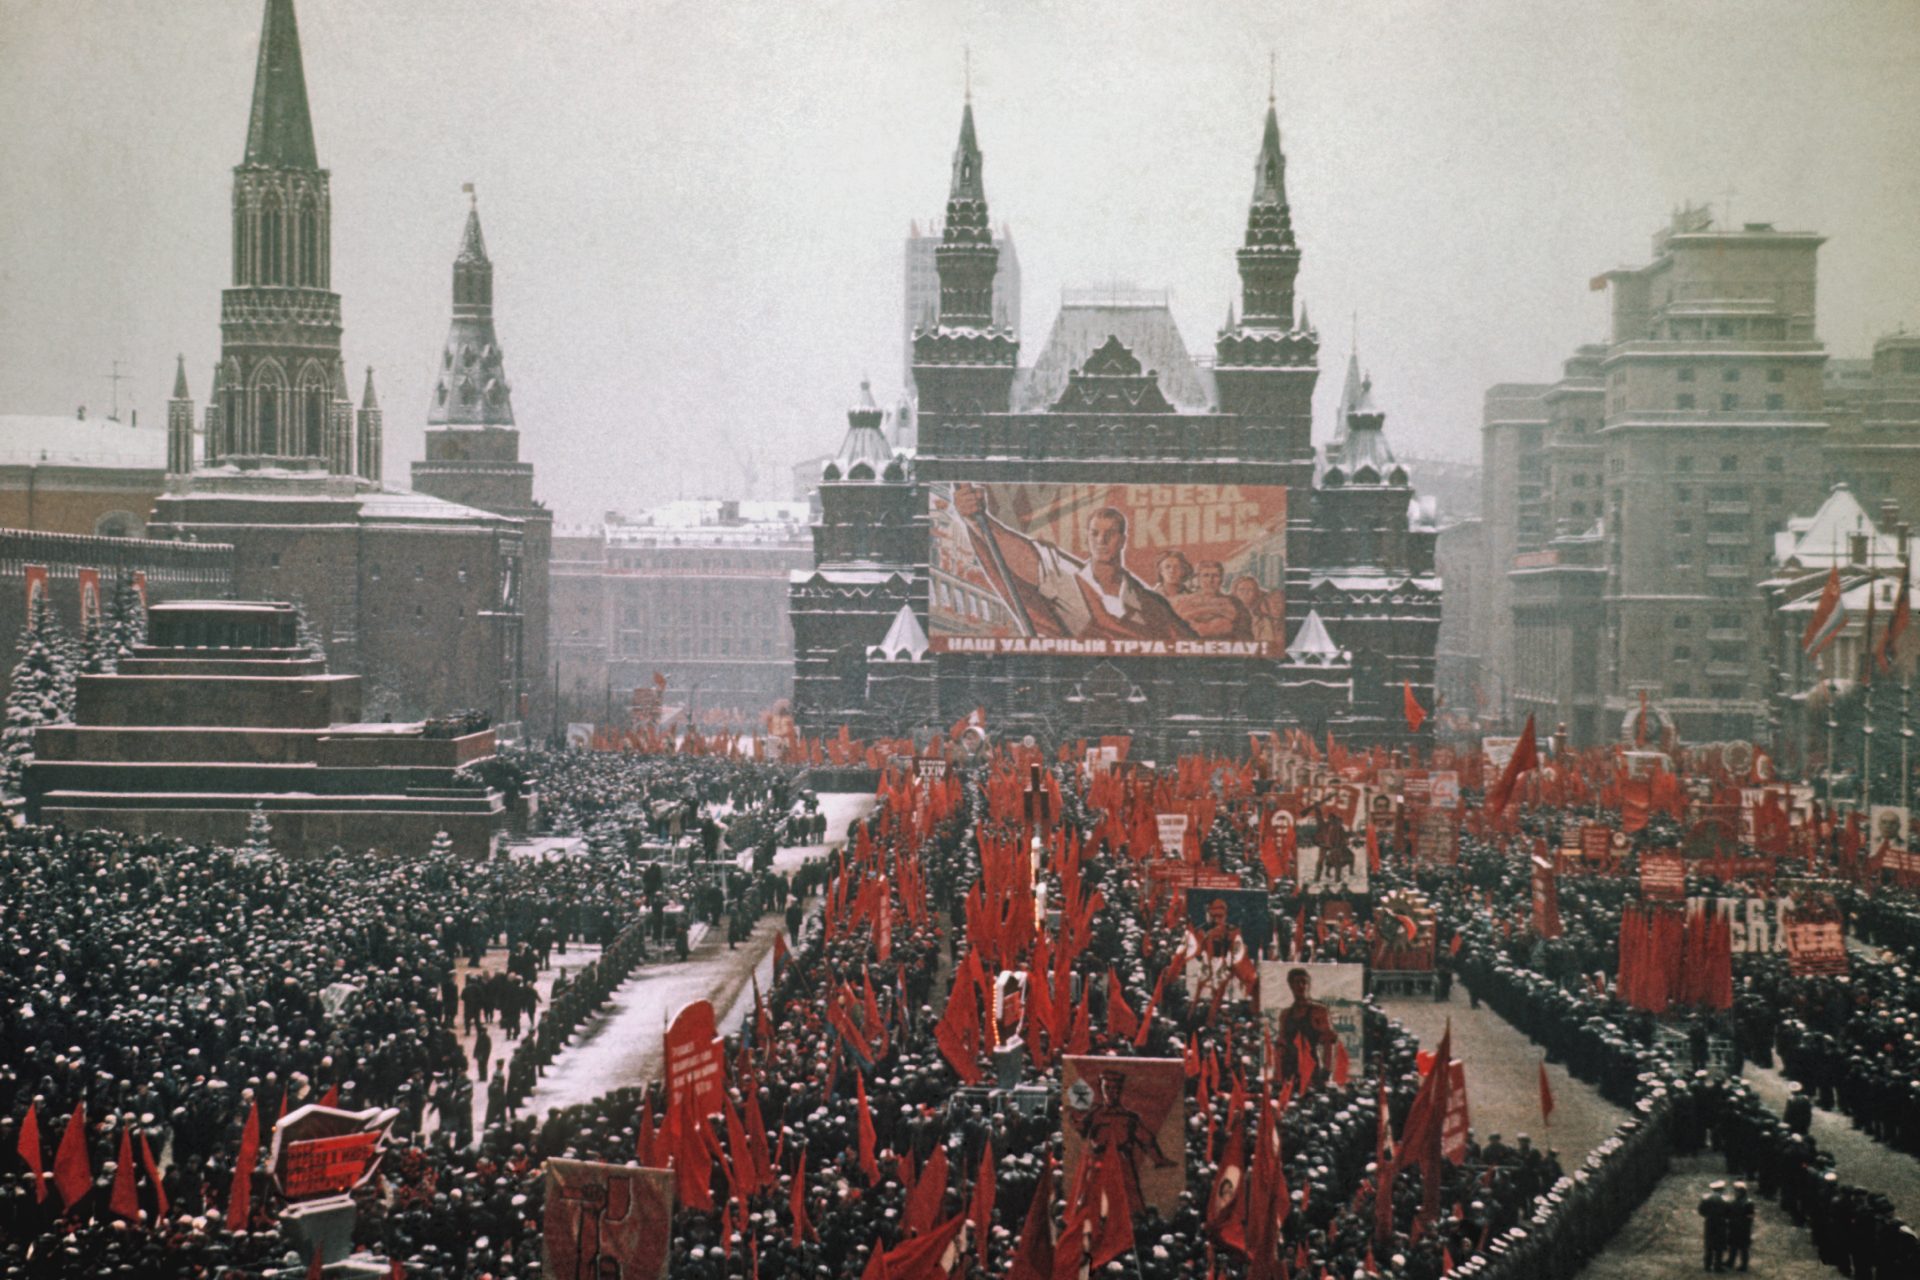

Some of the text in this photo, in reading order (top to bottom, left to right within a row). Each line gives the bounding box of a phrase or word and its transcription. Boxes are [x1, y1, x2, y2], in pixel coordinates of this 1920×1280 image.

[1126, 484, 1245, 507] СЪЕЗД
[1134, 502, 1260, 549] КПСС
[948, 637, 996, 651] НАШ
[1000, 637, 1107, 653] УДАРНЫЙ
